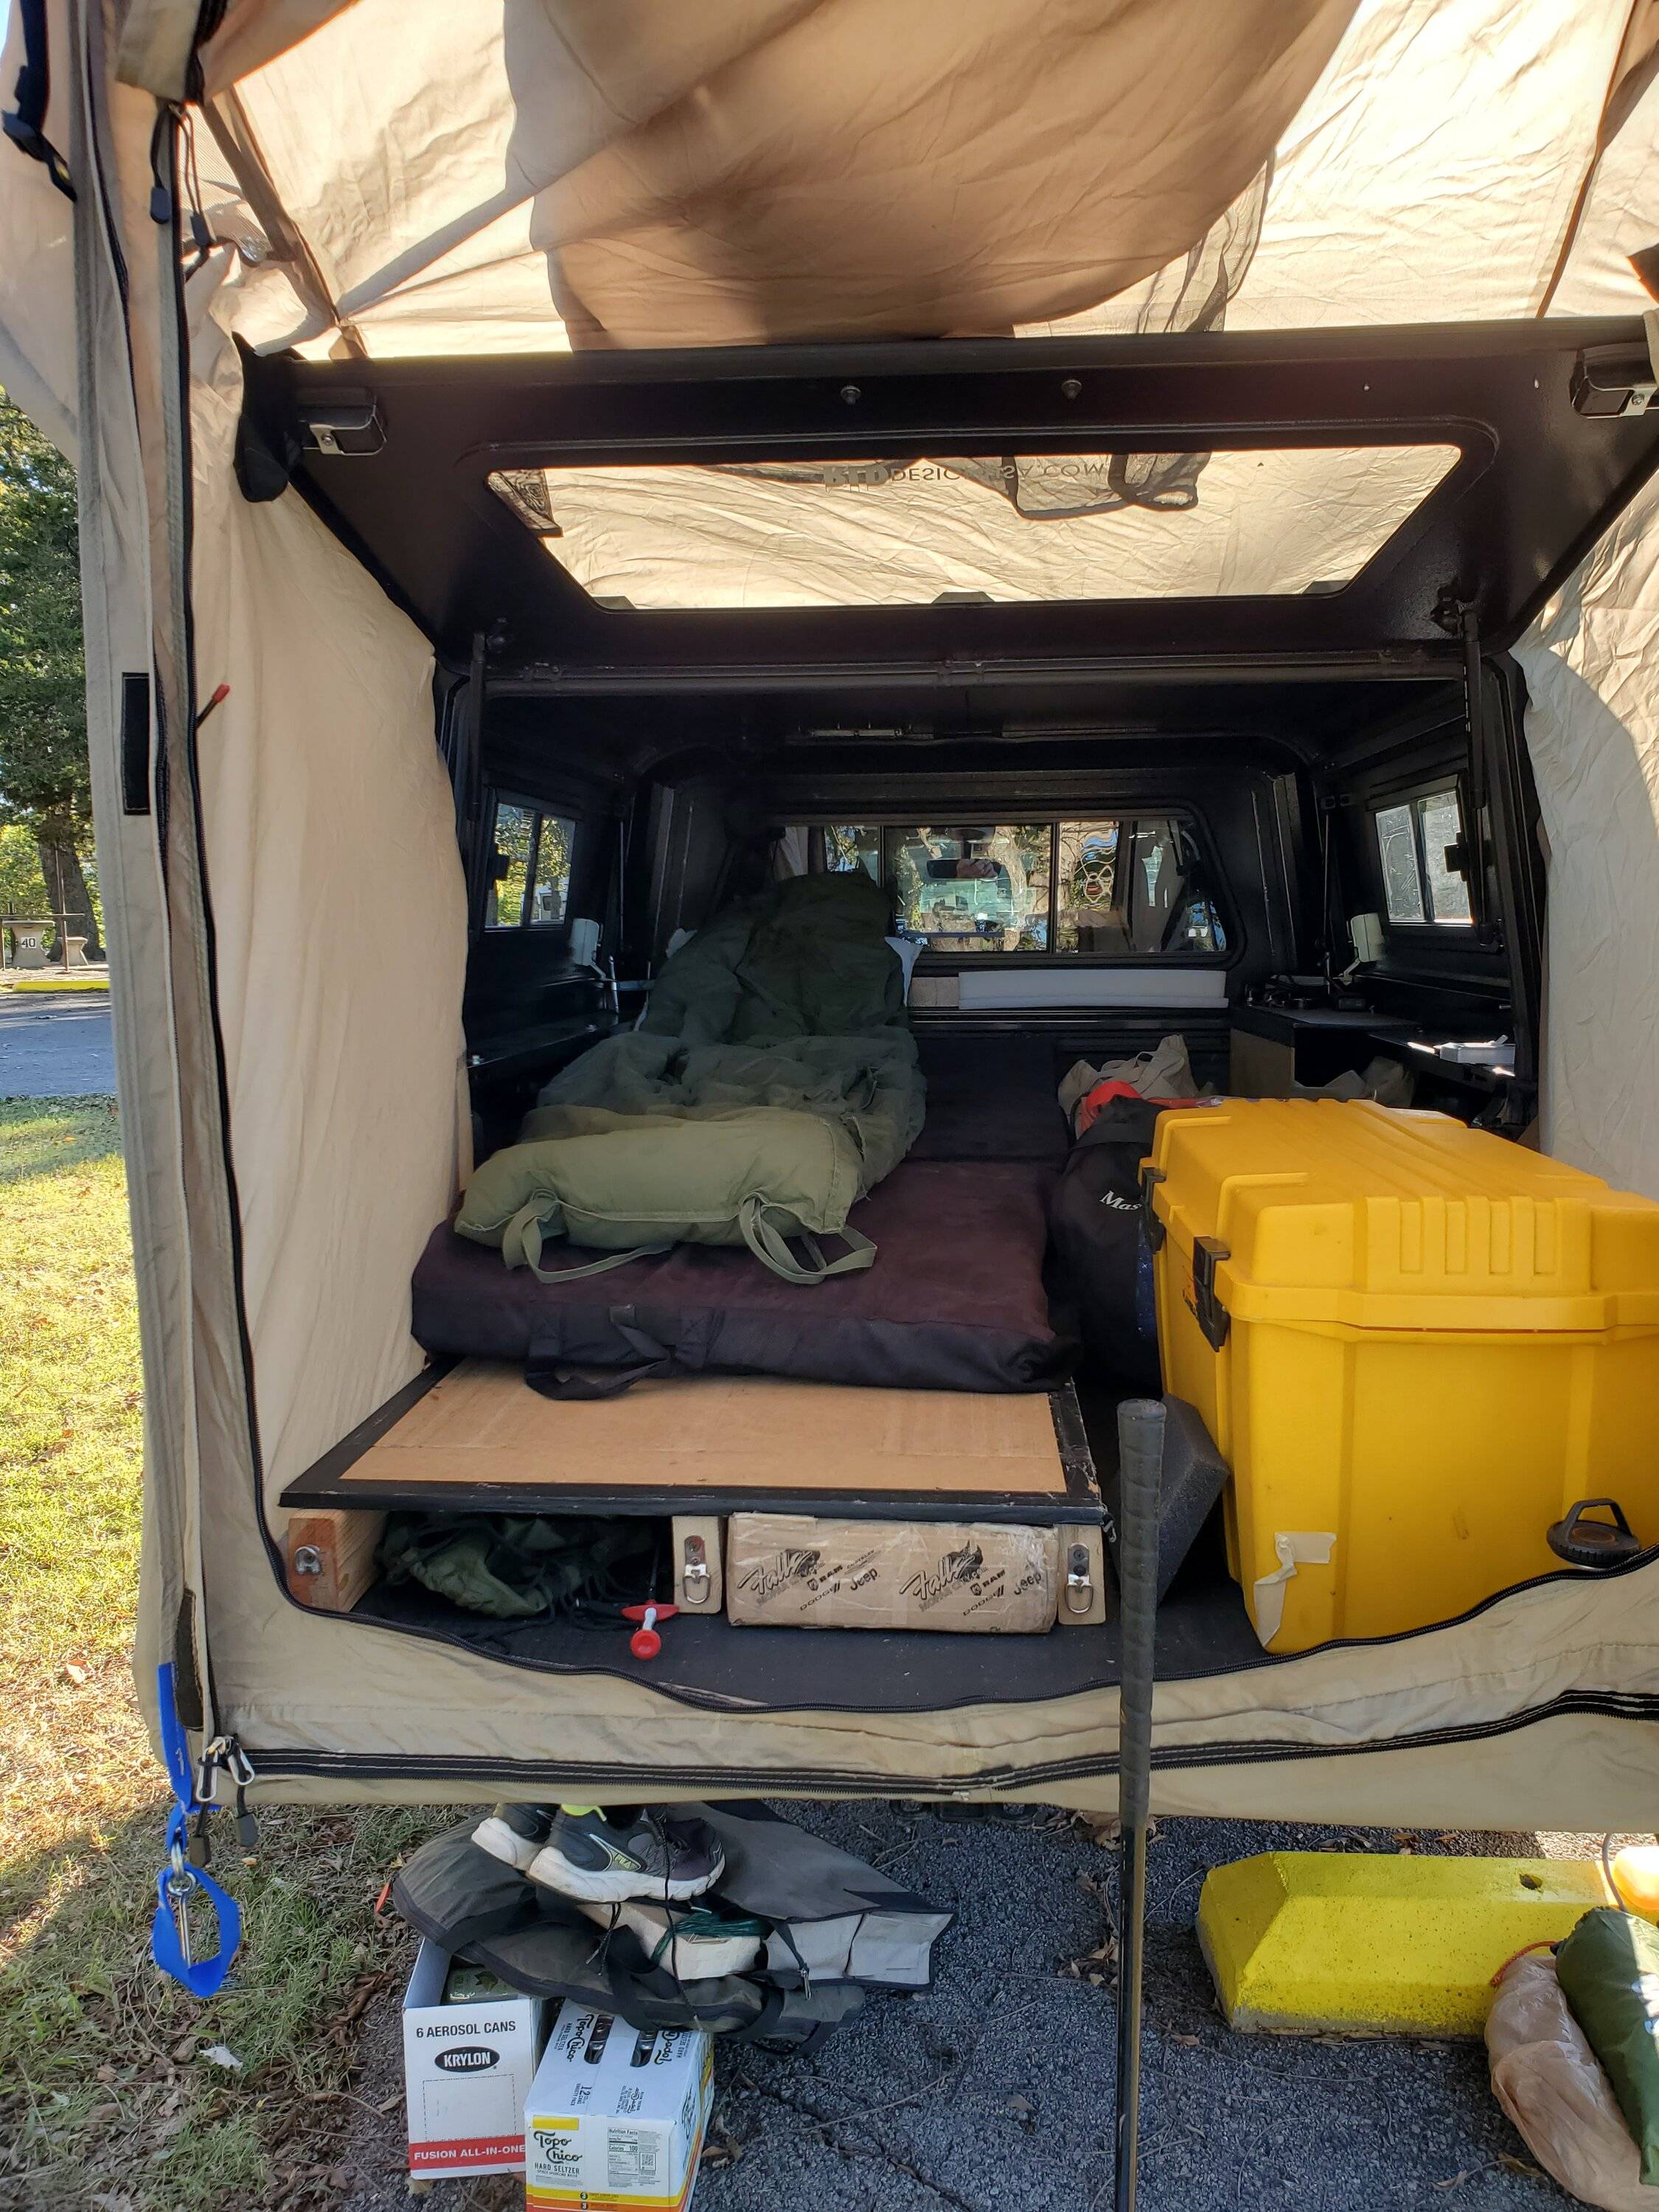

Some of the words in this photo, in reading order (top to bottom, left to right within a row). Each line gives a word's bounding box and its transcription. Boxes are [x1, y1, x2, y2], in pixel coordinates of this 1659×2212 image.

[21, 938, 35, 947] 40
[818, 1565, 844, 1583] RAM
[849, 1568, 878, 1591] Jeep
[981, 1569, 1006, 1588] RAM
[1013, 1572, 1042, 1596] Jeep
[416, 2027, 424, 2038] 6
[426, 2023, 481, 2037] AEROSOL
[484, 2020, 516, 2034] CANS
[444, 2051, 491, 2067] KRYLON
[580, 2085, 593, 2096] 12
[533, 2130, 572, 2149] Topo
[414, 2149, 457, 2160] FUSION
[459, 2143, 526, 2157] ALL-IN-ONE
[546, 2147, 583, 2164] Chico
[535, 2162, 552, 2171] HARD
[554, 2165, 580, 2174] SELTZER
